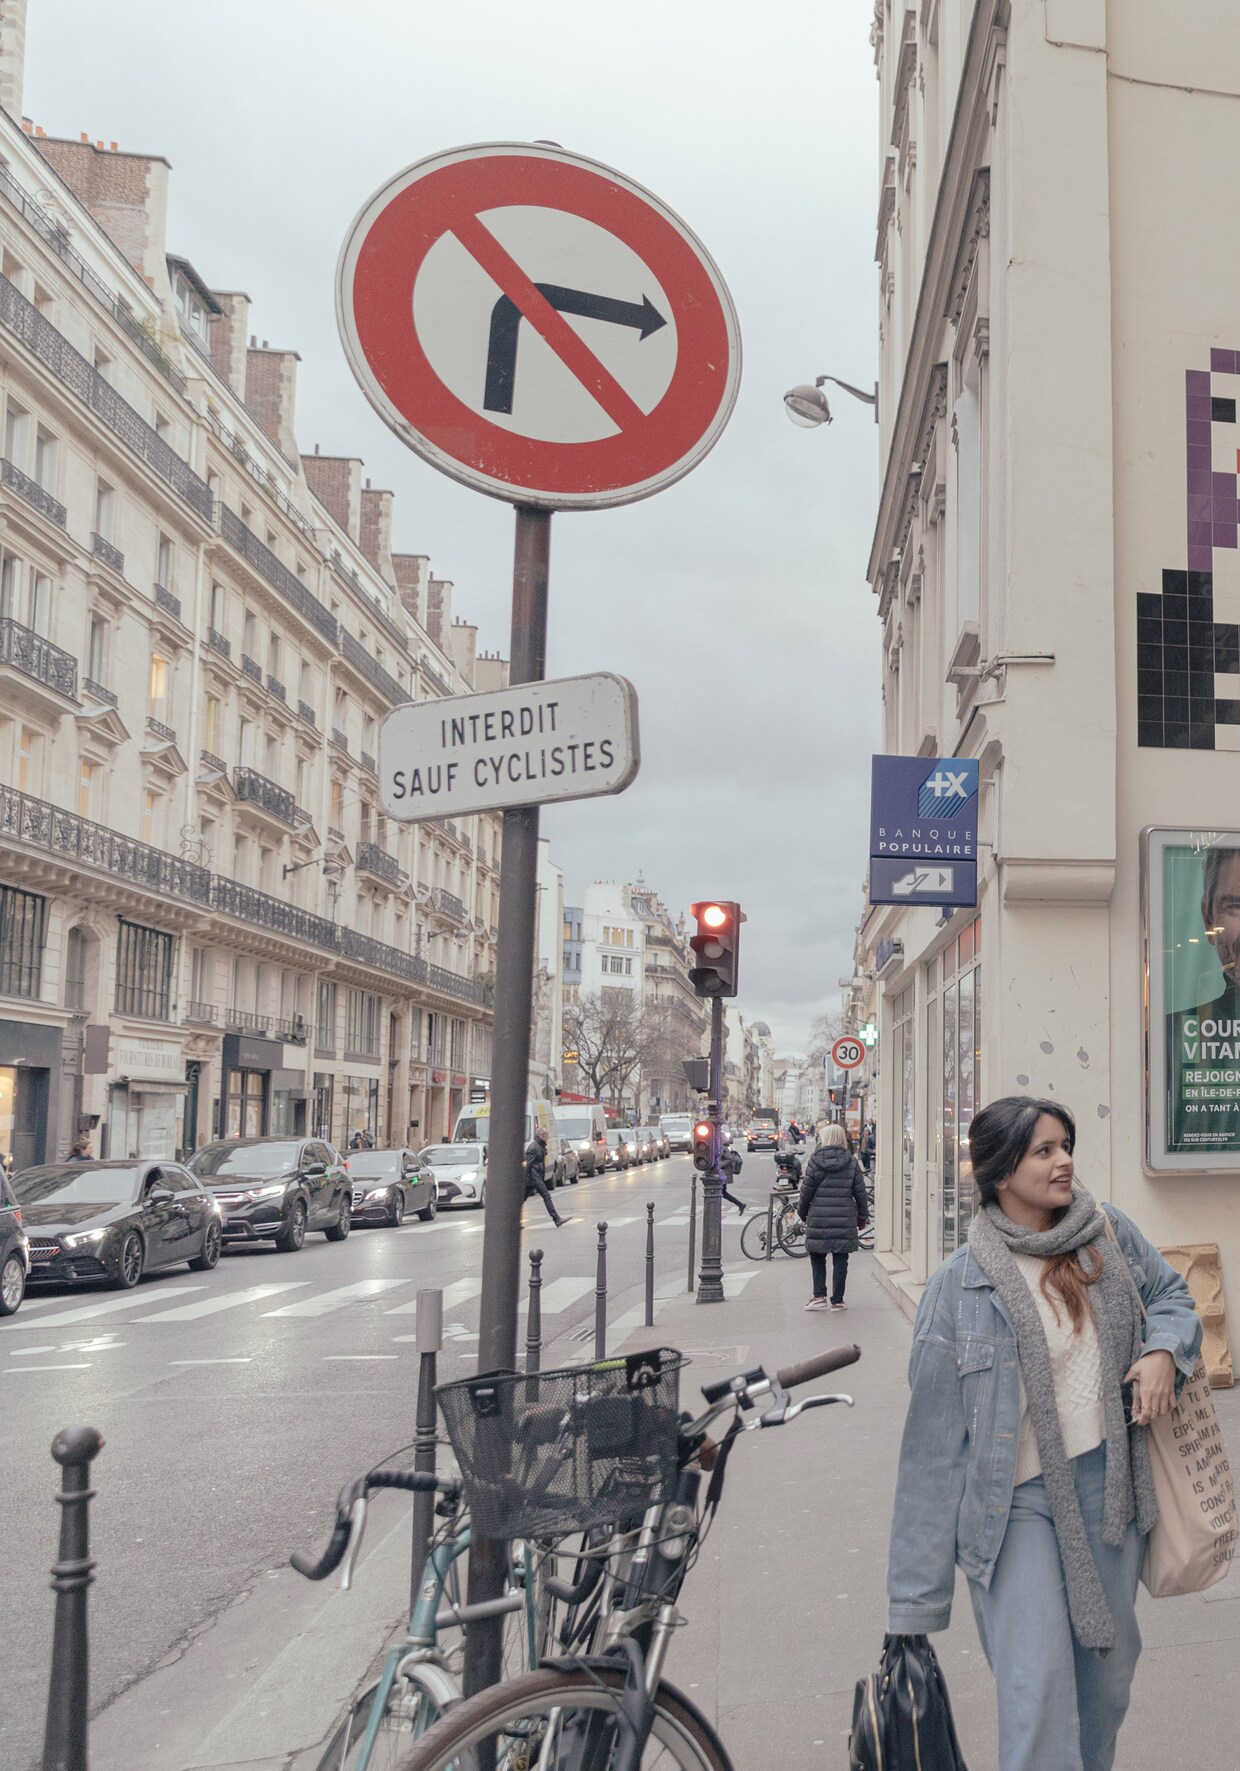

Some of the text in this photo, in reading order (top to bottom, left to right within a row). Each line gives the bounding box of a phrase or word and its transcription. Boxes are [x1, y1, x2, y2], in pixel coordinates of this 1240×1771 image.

[441, 702, 559, 748] INTERDIT
[392, 739, 615, 799] SAUF CYCLISTES
[879, 827, 972, 841] BANQUE
[879, 841, 972, 855] POPULAIRE
[839, 1046, 858, 1060] 30
[1185, 1089, 1198, 1098] EN
[1185, 1104, 1199, 1113] ON
[1200, 1104, 1207, 1112] A
[1209, 1104, 1231, 1112] TANT
[1233, 1102, 1240, 1112] À
[1192, 1480, 1205, 1495] IS
